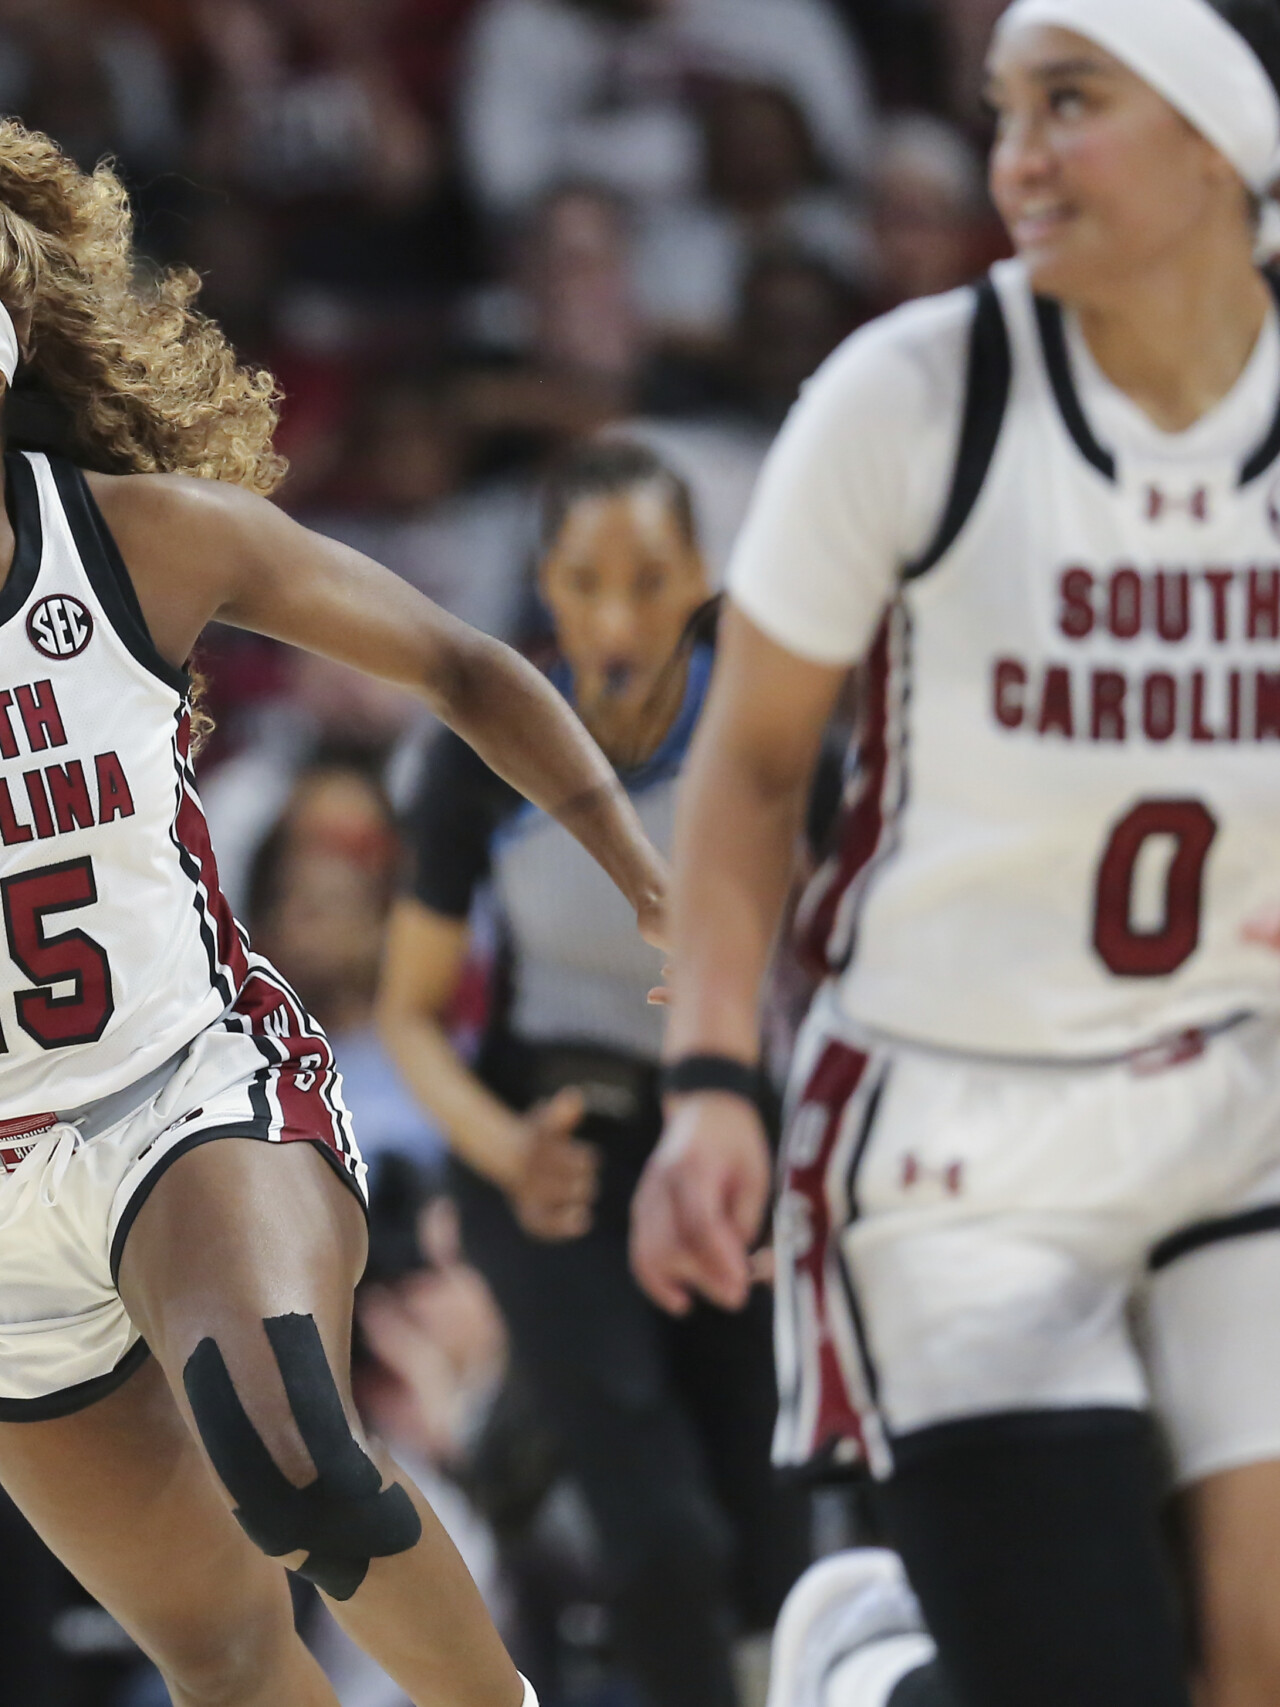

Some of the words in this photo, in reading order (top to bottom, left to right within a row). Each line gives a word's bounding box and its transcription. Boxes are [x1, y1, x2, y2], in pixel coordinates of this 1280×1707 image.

[31, 598, 88, 655] SEC
[1058, 567, 1280, 643] SOUTH
[1091, 797, 1218, 976] 0
